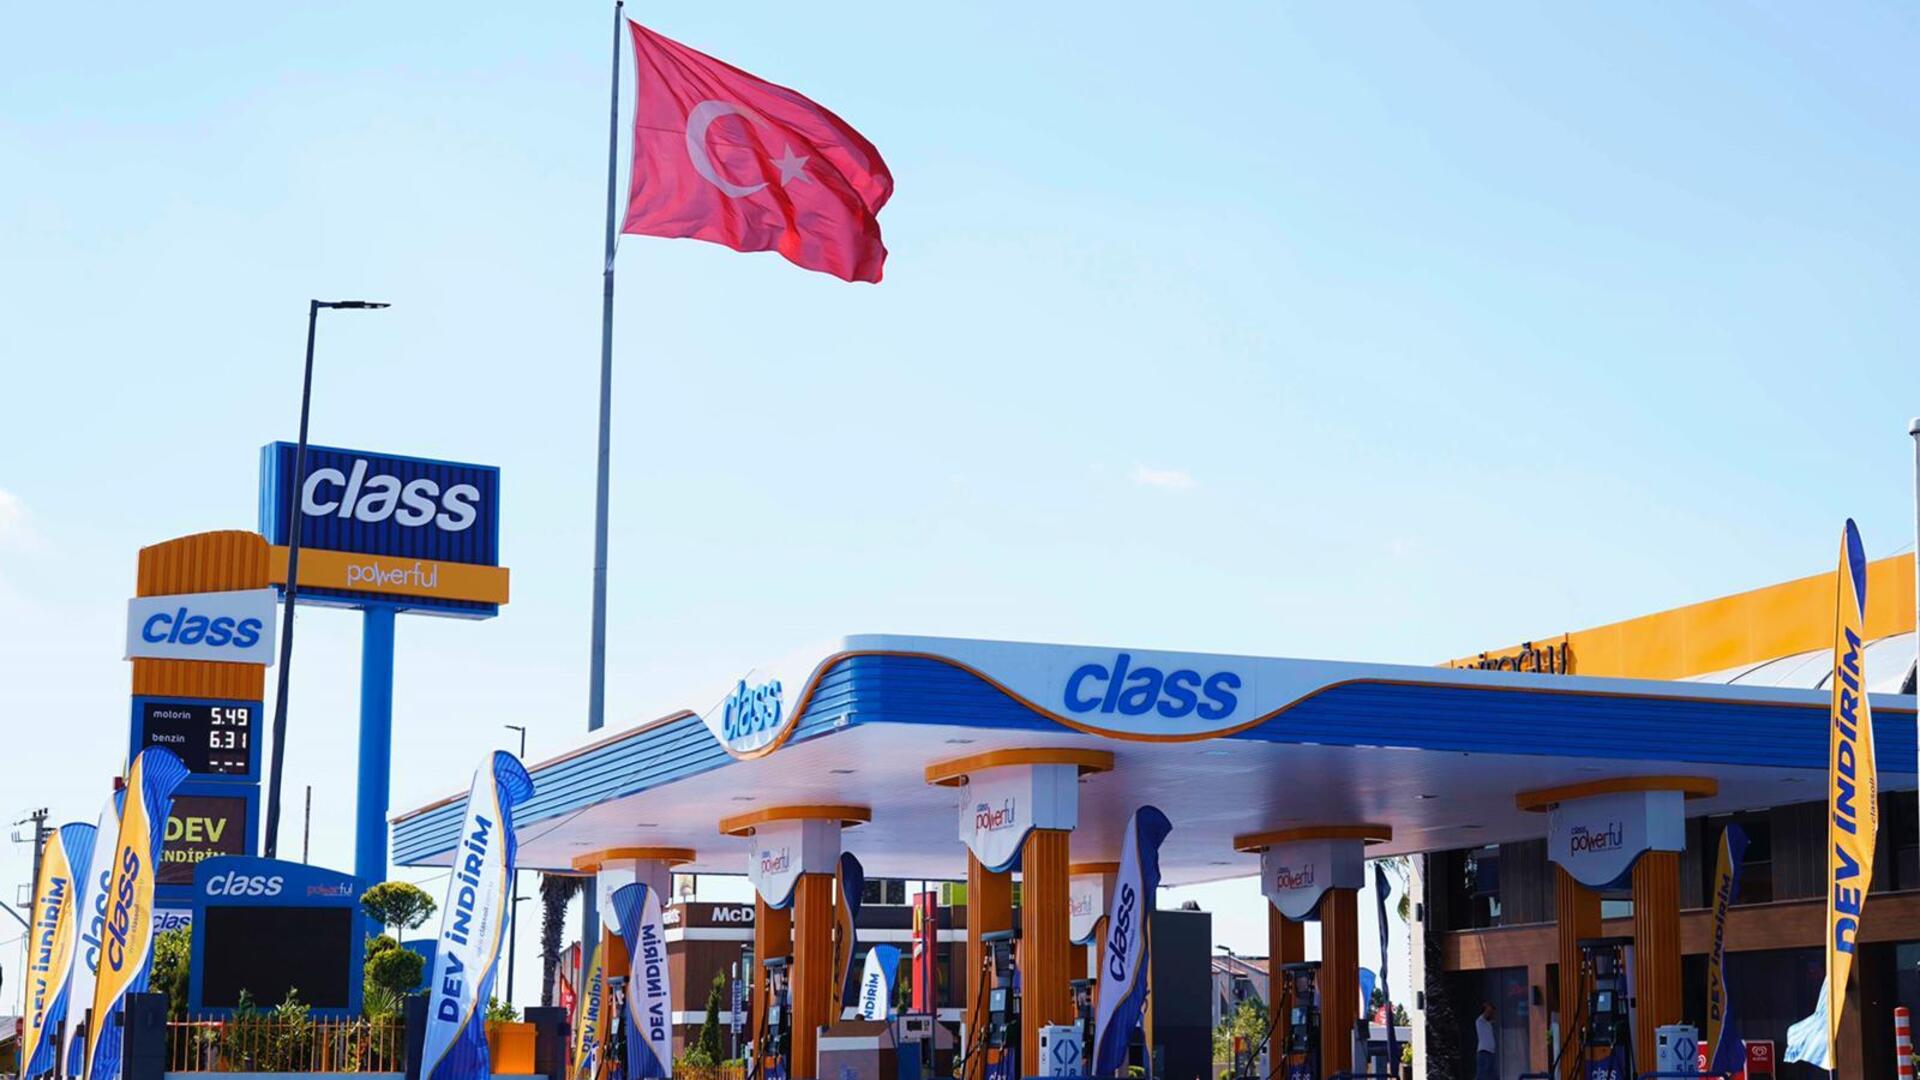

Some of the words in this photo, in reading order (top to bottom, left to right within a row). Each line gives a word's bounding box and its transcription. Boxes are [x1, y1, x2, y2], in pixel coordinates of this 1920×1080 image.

[301, 459, 480, 531] class
[347, 561, 437, 588] powerful
[142, 607, 262, 648] class
[1064, 654, 1241, 721] class
[153, 710, 191, 720] motorin
[211, 707, 248, 726] 5.49
[721, 680, 782, 741] class
[1833, 626, 1861, 835] İNDİRİM
[152, 733, 185, 743] benzin
[209, 730, 247, 749] 6.31
[164, 816, 227, 842] DEV
[976, 797, 1015, 835] powerful
[160, 848, 227, 863] NDİRİ
[1571, 822, 1623, 857] powerful
[206, 871, 284, 896] class
[445, 814, 492, 946] İNDİRİM
[1277, 864, 1314, 893] powerful
[1835, 843, 1861, 955] DEV
[108, 846, 140, 972] class
[153, 912, 191, 930] clas
[1109, 883, 1135, 982] class
[33, 979, 47, 1029] DEV
[438, 951, 464, 1023] DEV
[864, 973, 880, 1019] NDİRİM
